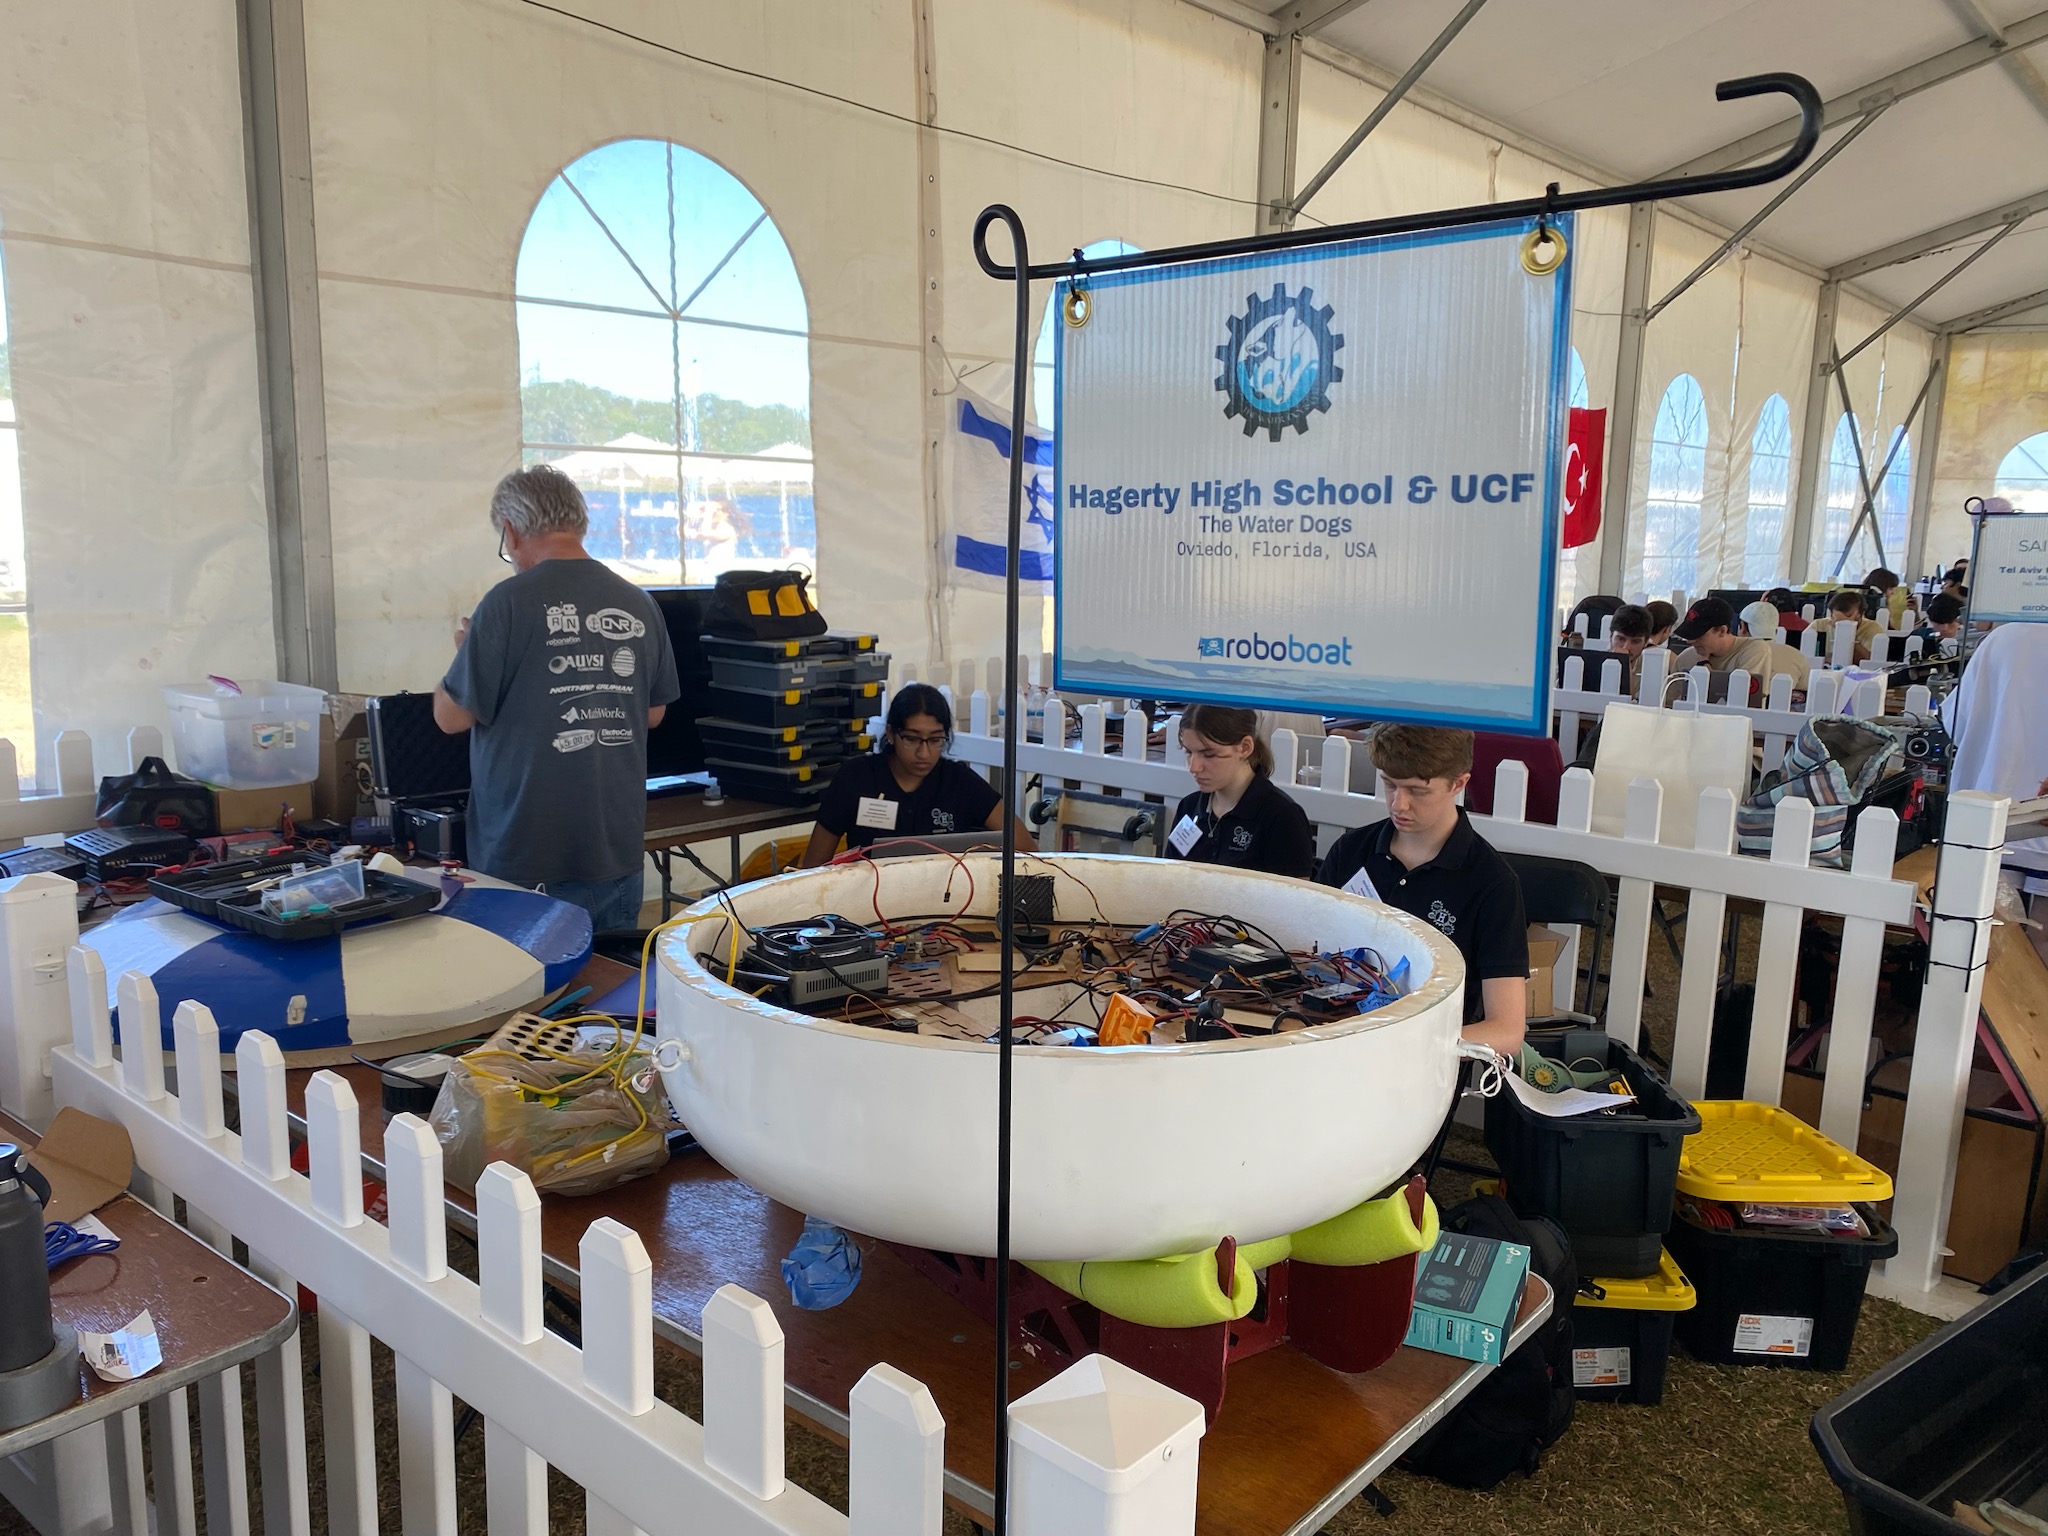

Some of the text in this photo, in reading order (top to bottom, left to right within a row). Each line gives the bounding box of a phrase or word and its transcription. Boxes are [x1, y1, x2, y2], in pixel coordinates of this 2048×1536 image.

[1069, 473, 1535, 514] Hagerty High School & UCF
[1199, 514, 1352, 537] The Water Dogs
[1177, 541, 1378, 560] Oviedo, Florida, USA
[1999, 566, 2016, 574] Tel
[2019, 566, 2043, 574] Aviv
[1226, 632, 1352, 666] roboboat
[566, 654, 604, 668] AUVSI
[1575, 1351, 1597, 1359] HDX
